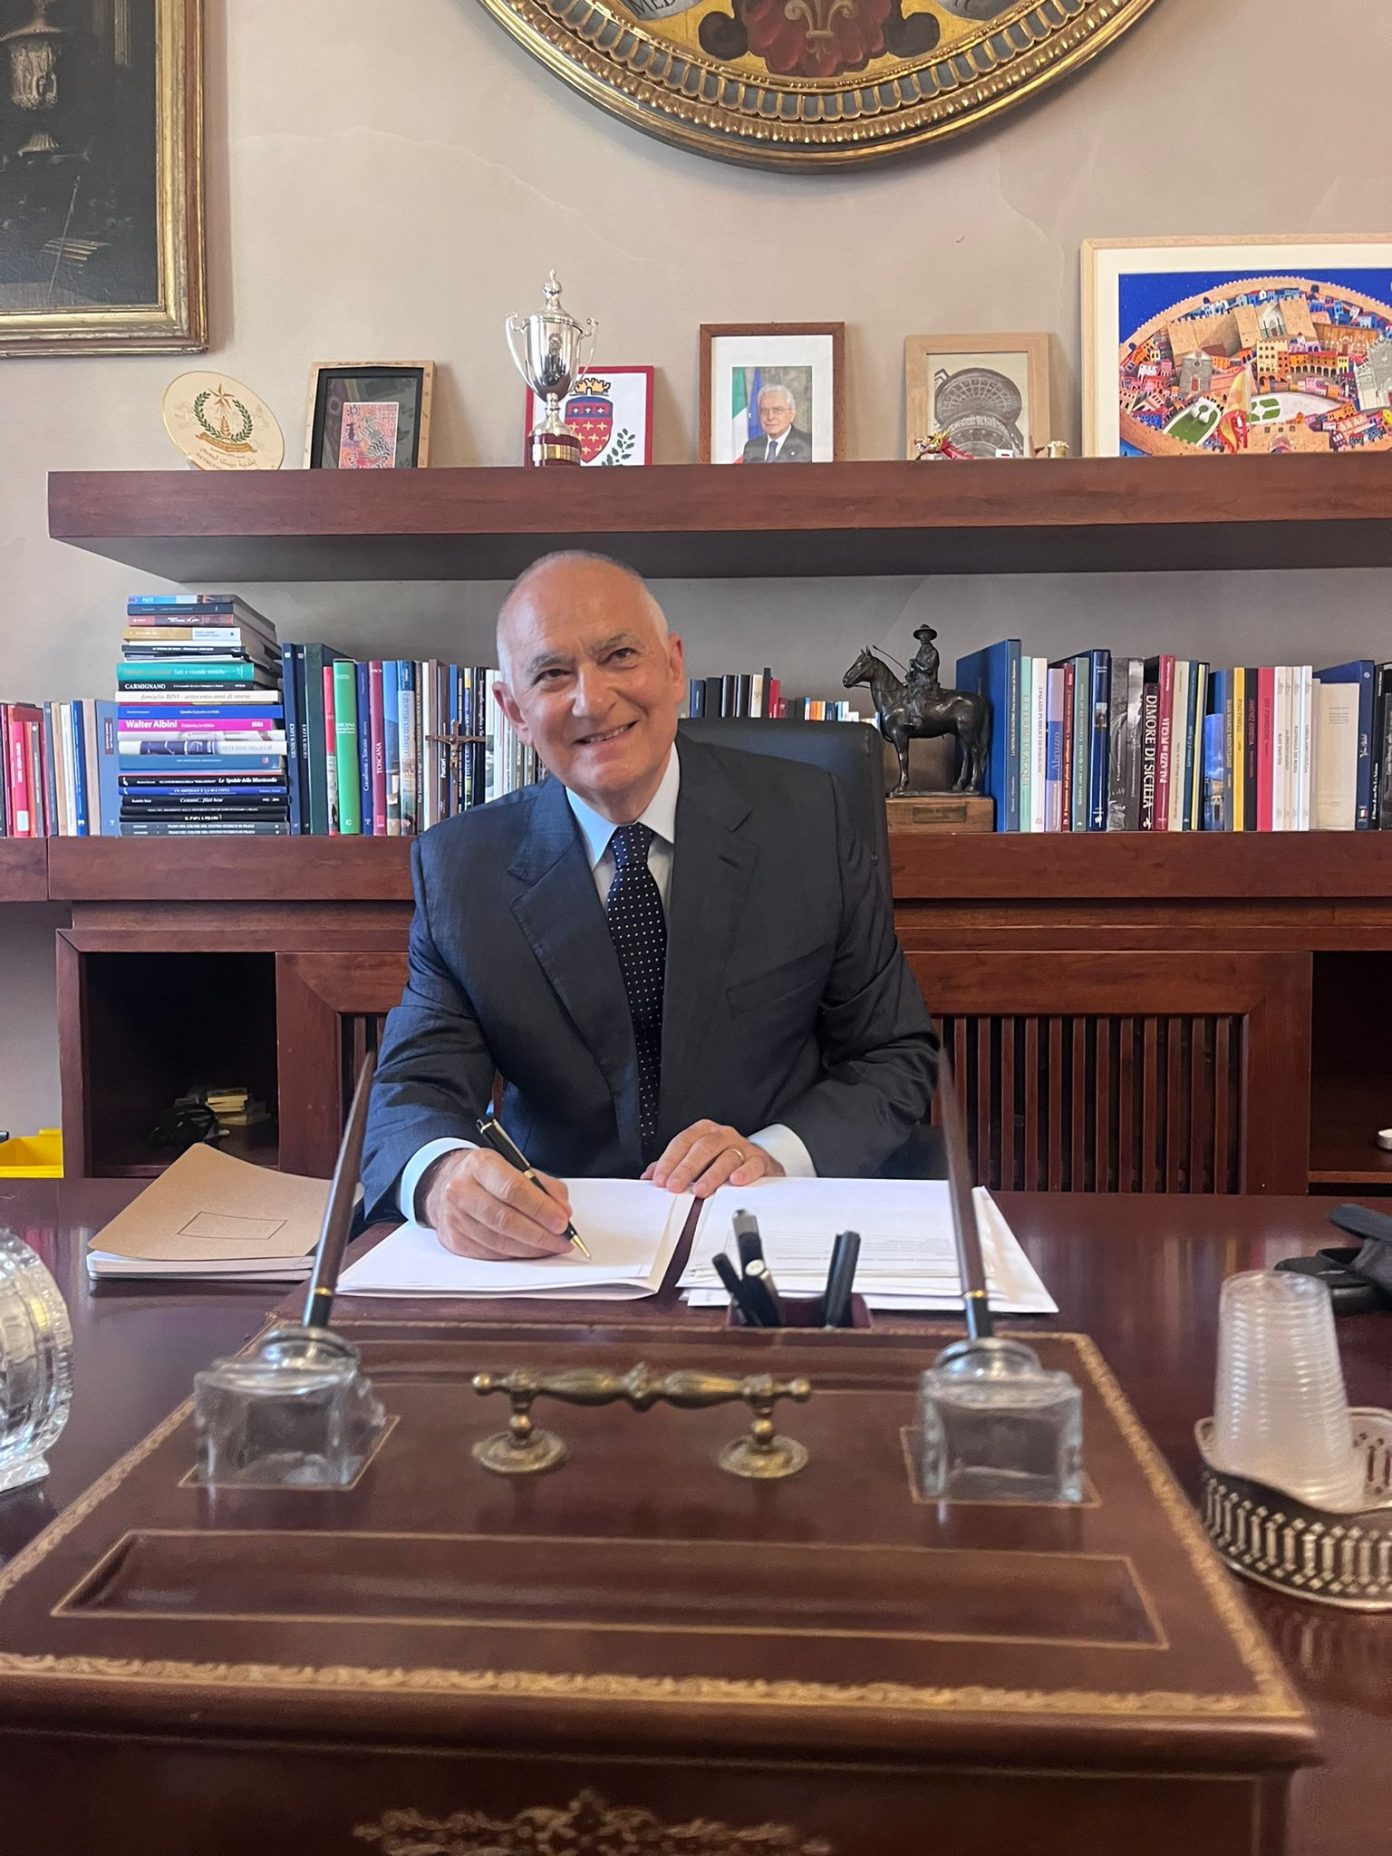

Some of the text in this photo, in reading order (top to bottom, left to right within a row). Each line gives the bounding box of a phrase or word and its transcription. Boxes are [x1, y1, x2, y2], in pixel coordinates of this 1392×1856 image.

[125, 720, 152, 728] Walter
[153, 720, 178, 728] Albini
[1161, 718, 1169, 744] PUGLIA
[1051, 732, 1060, 770] Abruzzo
[1142, 695, 1158, 808] DIMORE DI SICILIA
[1160, 753, 1168, 783] PALAZZI
